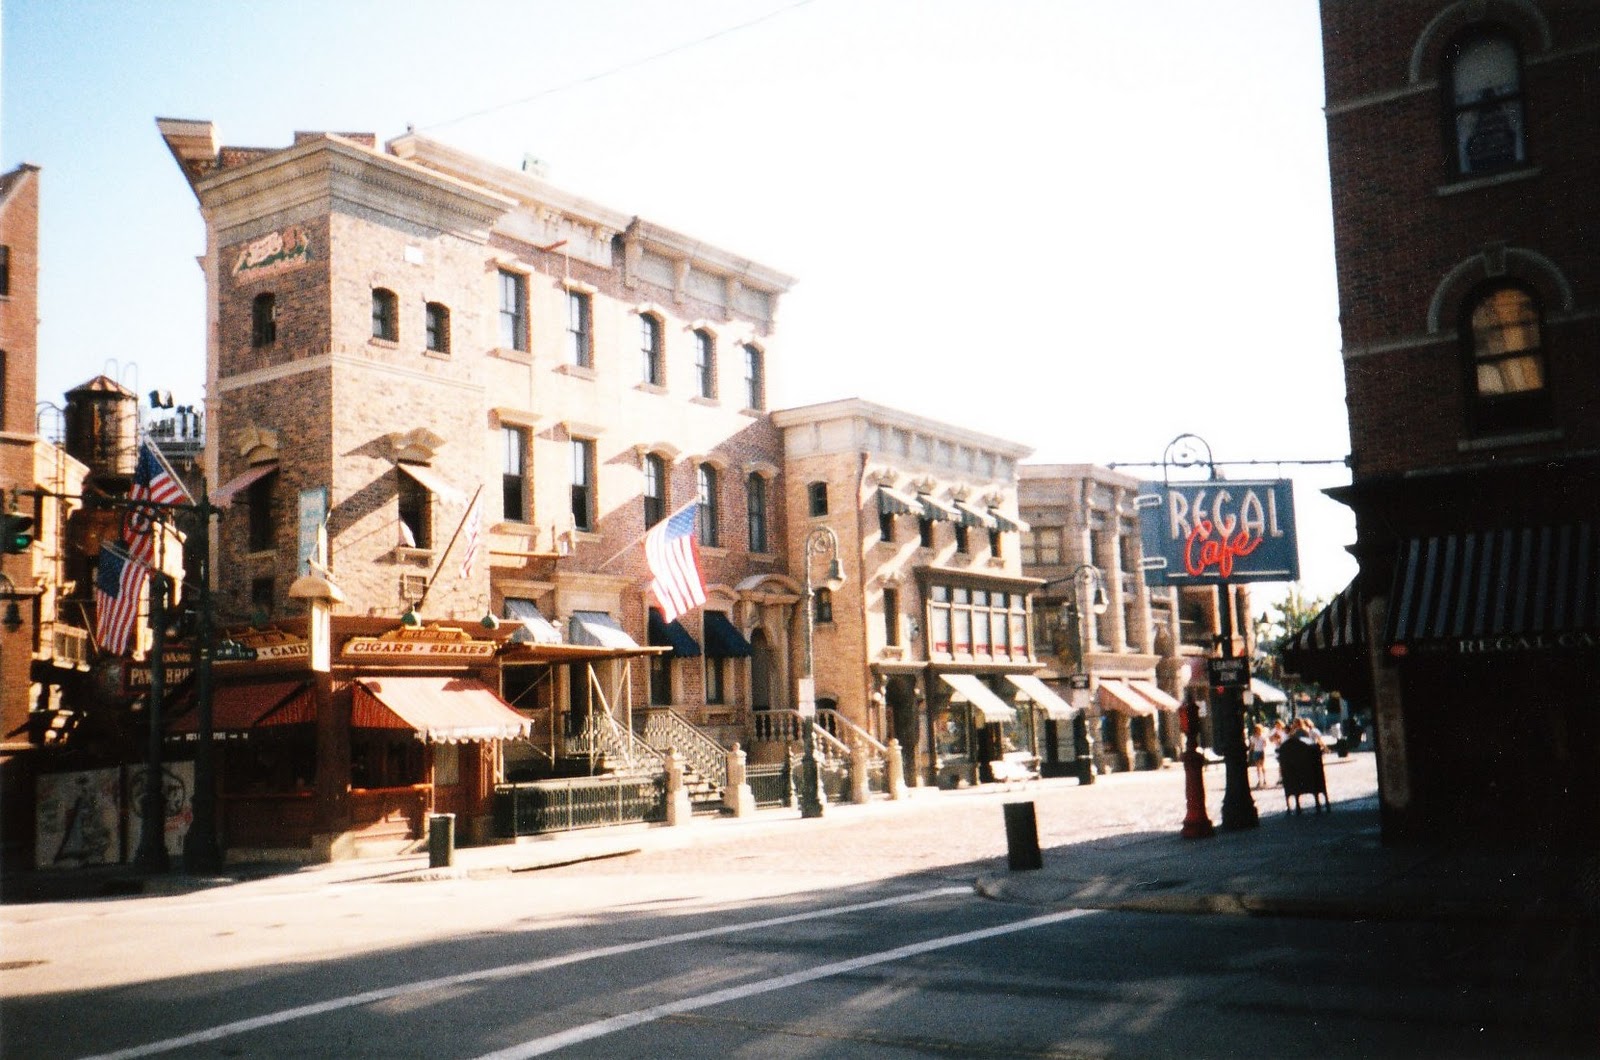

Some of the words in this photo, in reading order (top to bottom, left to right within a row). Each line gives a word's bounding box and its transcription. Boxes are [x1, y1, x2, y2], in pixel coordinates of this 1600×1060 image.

[1168, 488, 1284, 540] REGAL
[1184, 520, 1264, 578] Cafe
[270, 645, 308, 656] CAND
[353, 642, 413, 653] CIGARS
[429, 644, 489, 654] SHAKES
[1458, 635, 1549, 653] REGAL
